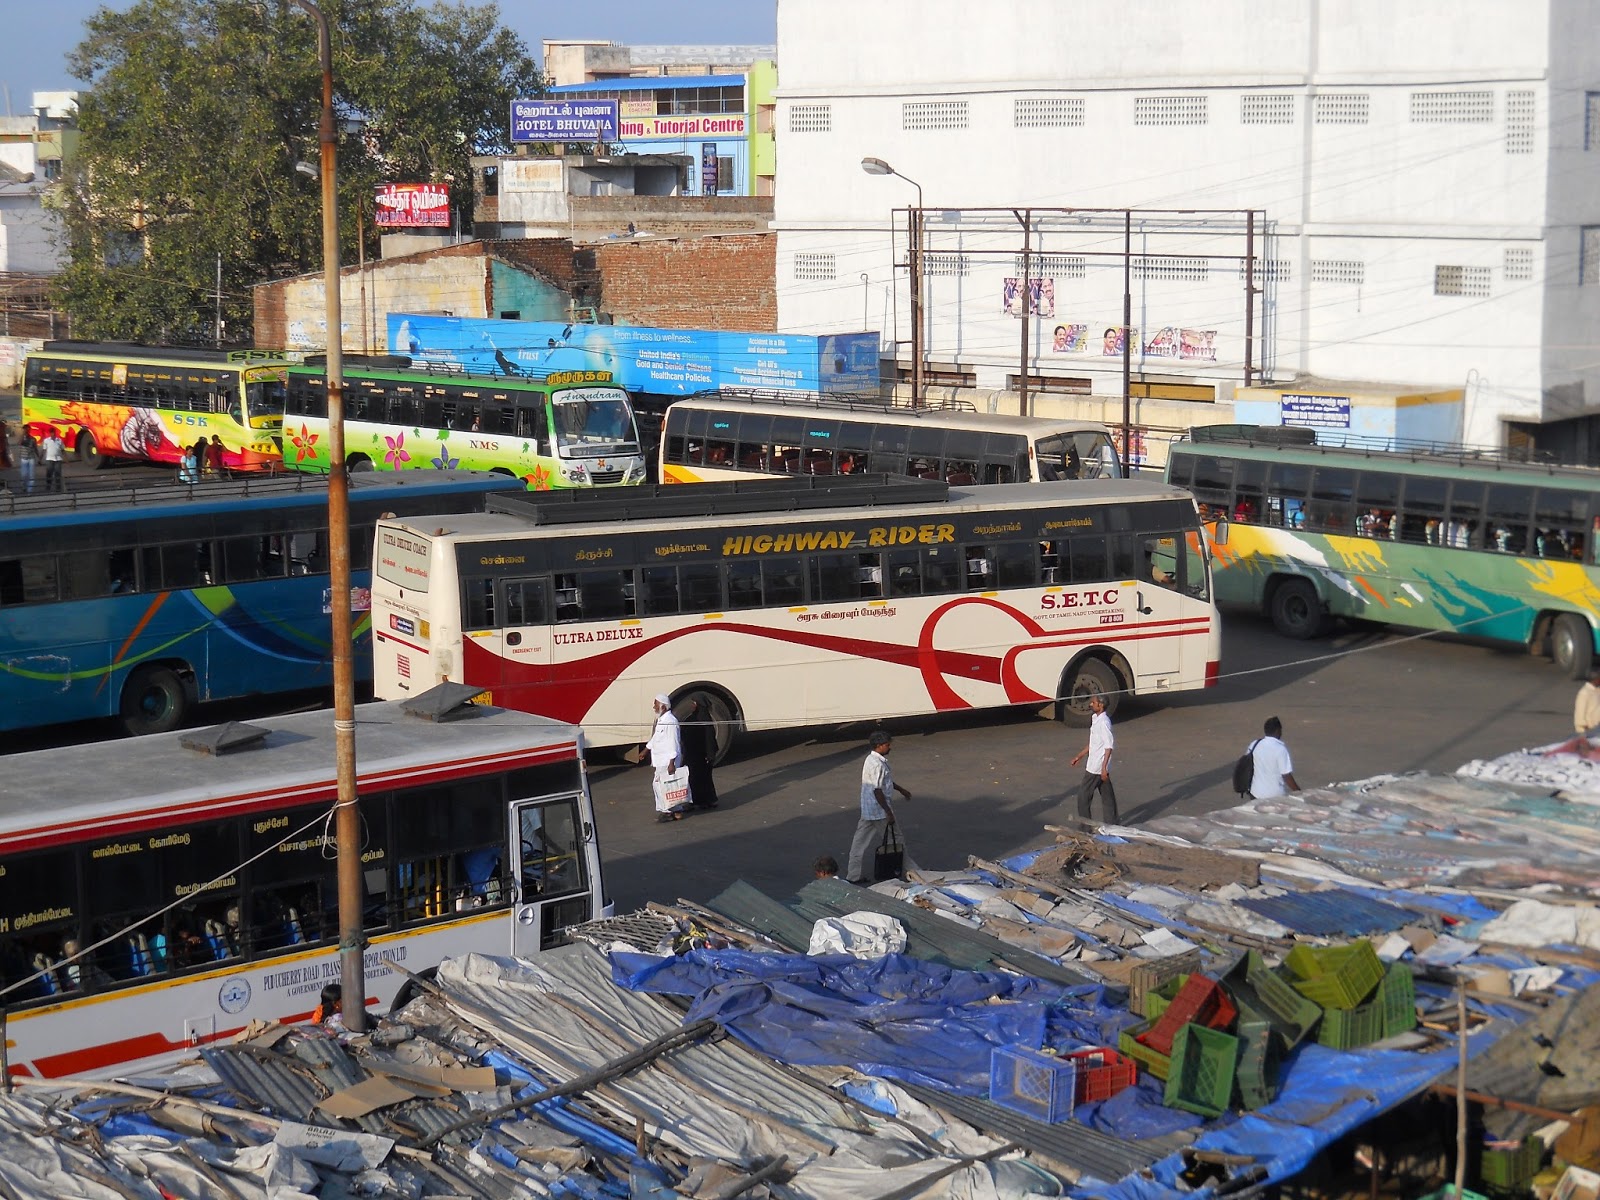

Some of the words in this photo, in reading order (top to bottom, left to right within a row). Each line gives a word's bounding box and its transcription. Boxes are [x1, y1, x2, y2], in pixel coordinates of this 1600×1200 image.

[515, 103, 573, 119] ஹோட்டல்
[574, 106, 612, 118] புவனா
[516, 120, 554, 131] HOTEL
[556, 119, 613, 130] BHUVANA
[619, 120, 644, 136] hing
[653, 119, 699, 134] Tutorial
[702, 118, 744, 133] Centre
[613, 329, 632, 340] From
[654, 333, 661, 342] to
[230, 351, 284, 362] SSK
[638, 349, 660, 359] United
[660, 350, 681, 360] India's
[635, 359, 651, 369] Gold
[651, 360, 664, 369] and
[650, 370, 685, 381] Healthcare
[685, 372, 713, 383] Policies.
[559, 390, 621, 402] Anandram
[173, 414, 208, 427] SSK
[469, 440, 499, 451] NMS
[722, 529, 855, 556] HIGHWAY
[868, 523, 955, 547] RIDER
[480, 554, 525, 566] சென்னை
[575, 547, 613, 560] திருச்சி
[1040, 589, 1119, 610] S.E.T.C
[796, 613, 819, 622] அரசு
[820, 608, 860, 620] விரைவுப்
[860, 605, 897, 618] பேருந்து
[553, 631, 595, 645] ULTRA
[596, 627, 644, 642] DELUXE
[149, 832, 191, 849] கோரிமேடு
[303, 964, 320, 982] ROAD
[321, 959, 342, 979] TRANS
[364, 948, 396, 969] RPORATION
